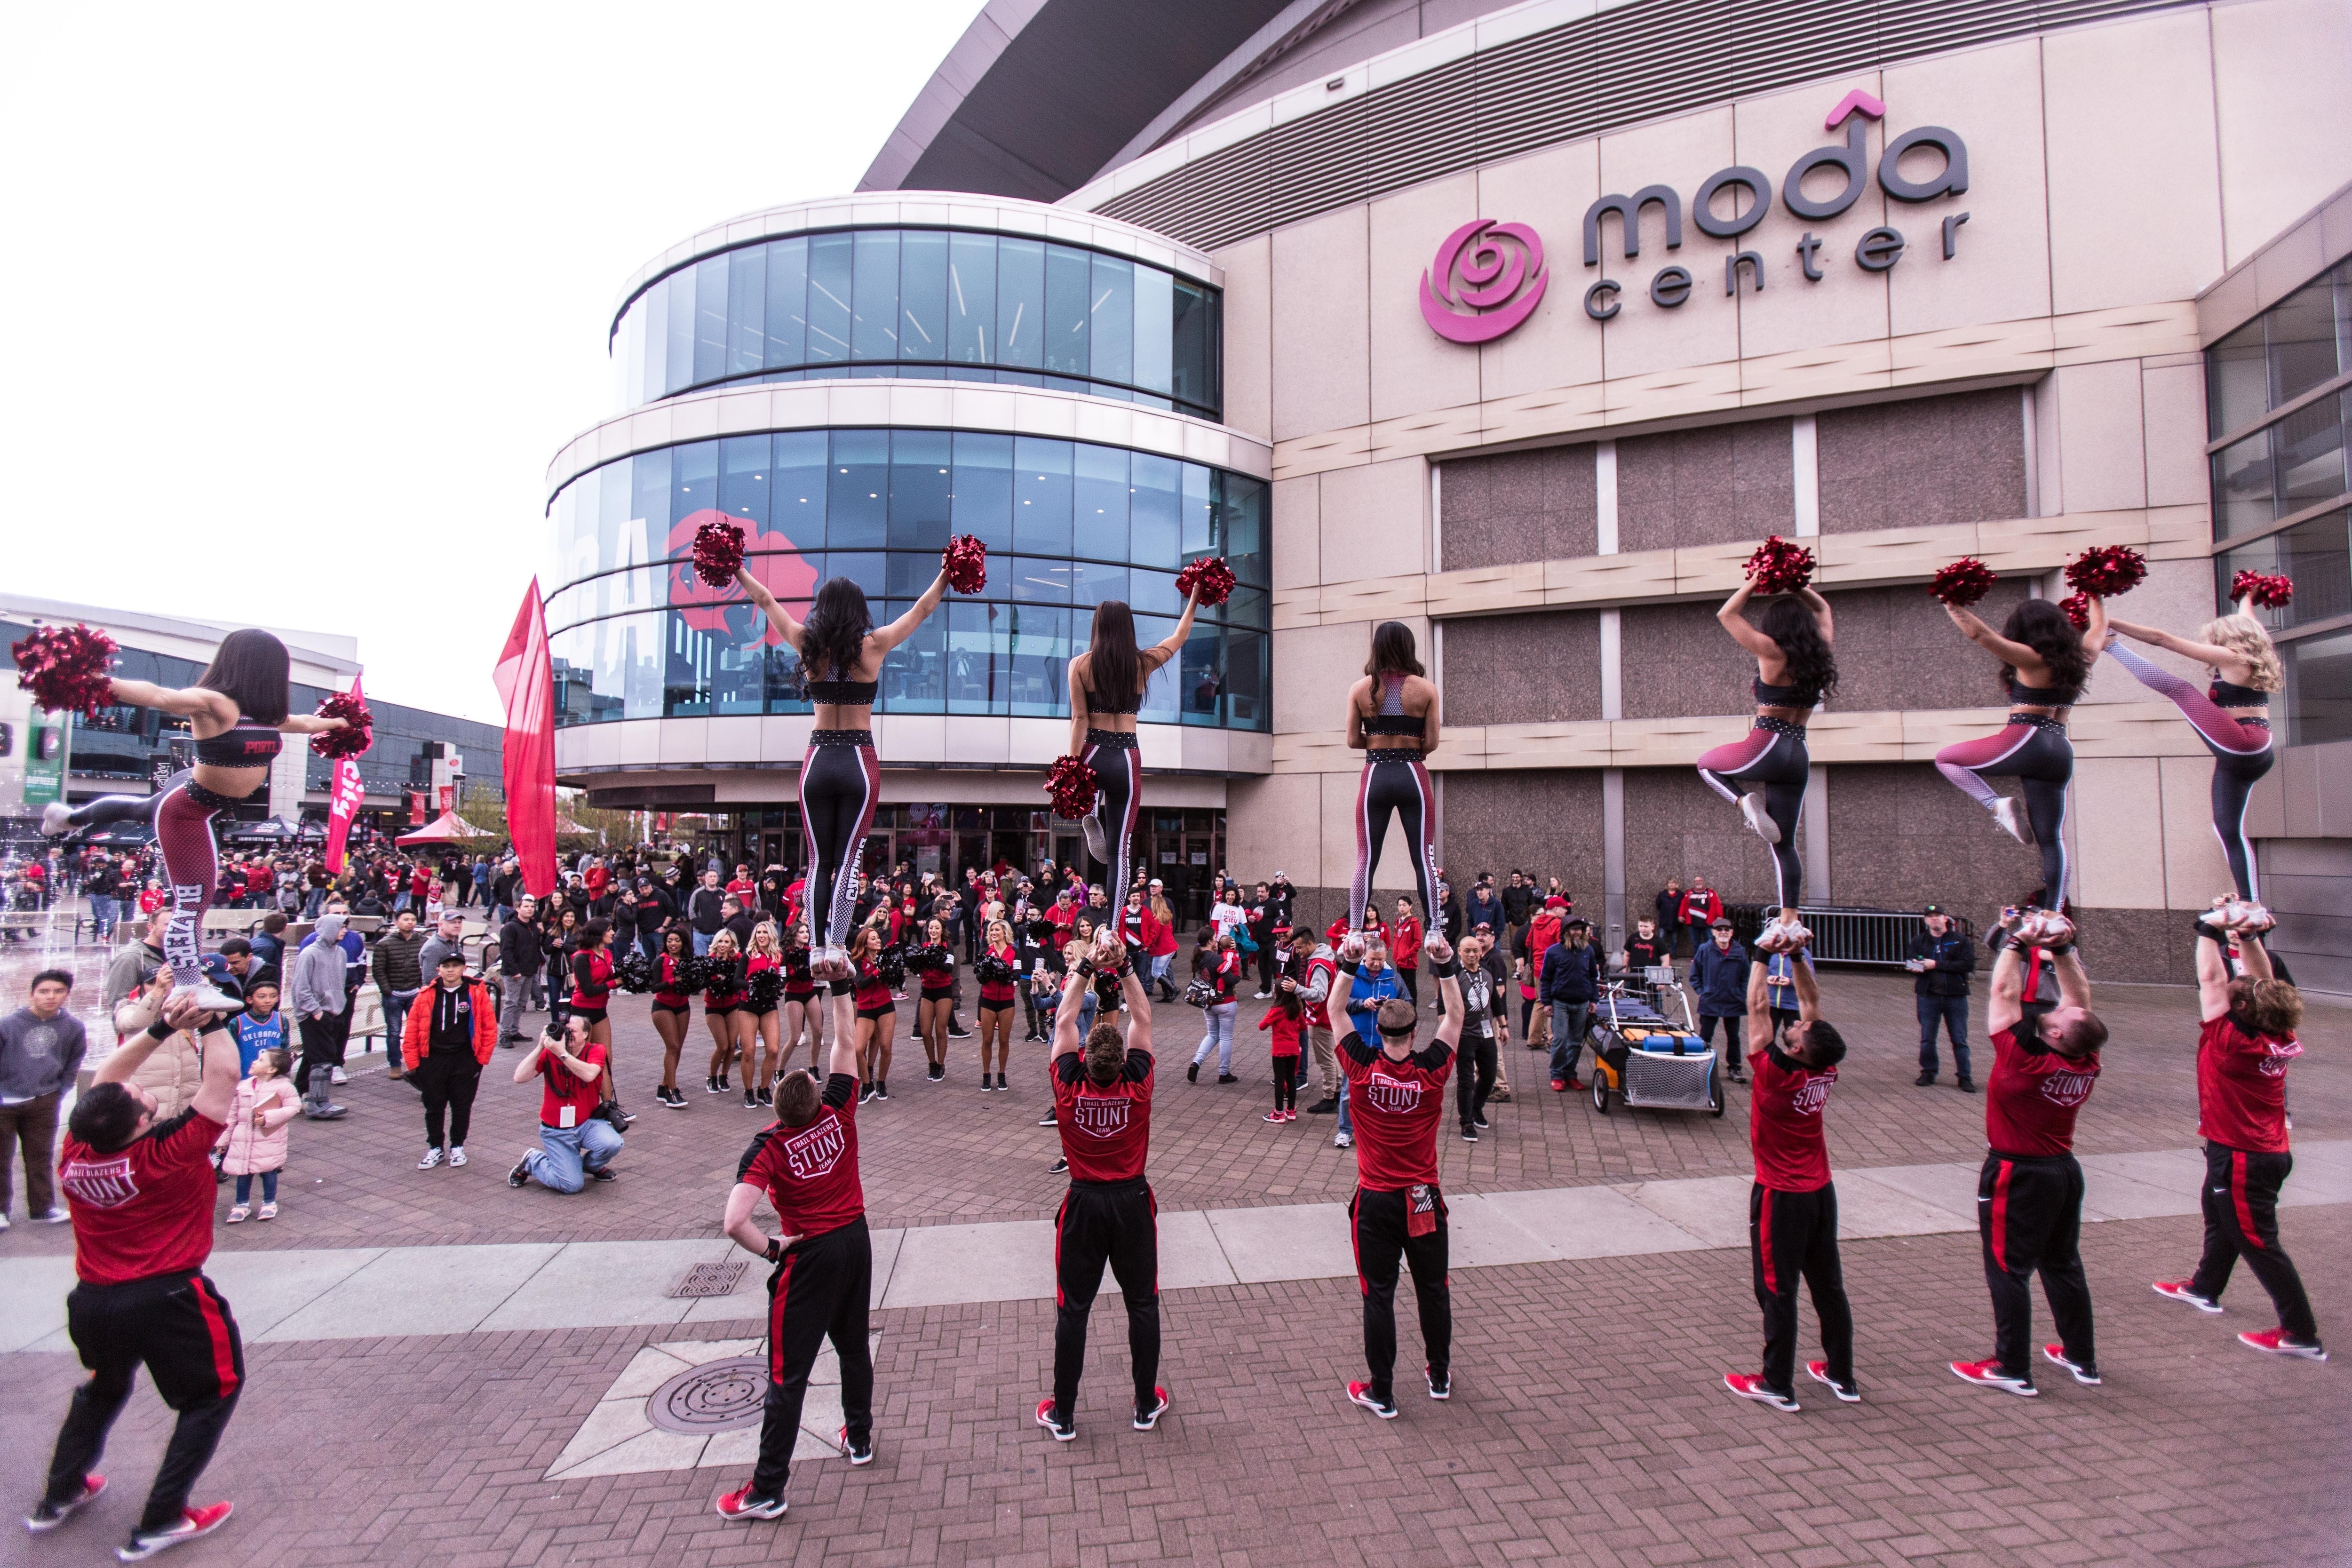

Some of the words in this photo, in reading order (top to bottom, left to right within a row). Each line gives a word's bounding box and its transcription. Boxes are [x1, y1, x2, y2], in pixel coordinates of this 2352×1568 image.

[1583, 89, 1969, 267] moda
[1584, 212, 1971, 320] center
[332, 760, 365, 820] city
[164, 884, 202, 970] BLAZERS
[242, 1030, 281, 1042] OKLAHOMA
[1368, 1085, 1424, 1106] STUNT
[2042, 1075, 2094, 1095] STUNT
[1075, 1105, 1131, 1126] STUNT
[792, 1137, 810, 1150] TRAIL
[810, 1122, 834, 1140] BLAZERS
[789, 1125, 845, 1176] STUNT
[818, 1157, 833, 1171] TEAM
[62, 1170, 136, 1199] STUNT
[87, 1166, 121, 1177] BLAZERS
